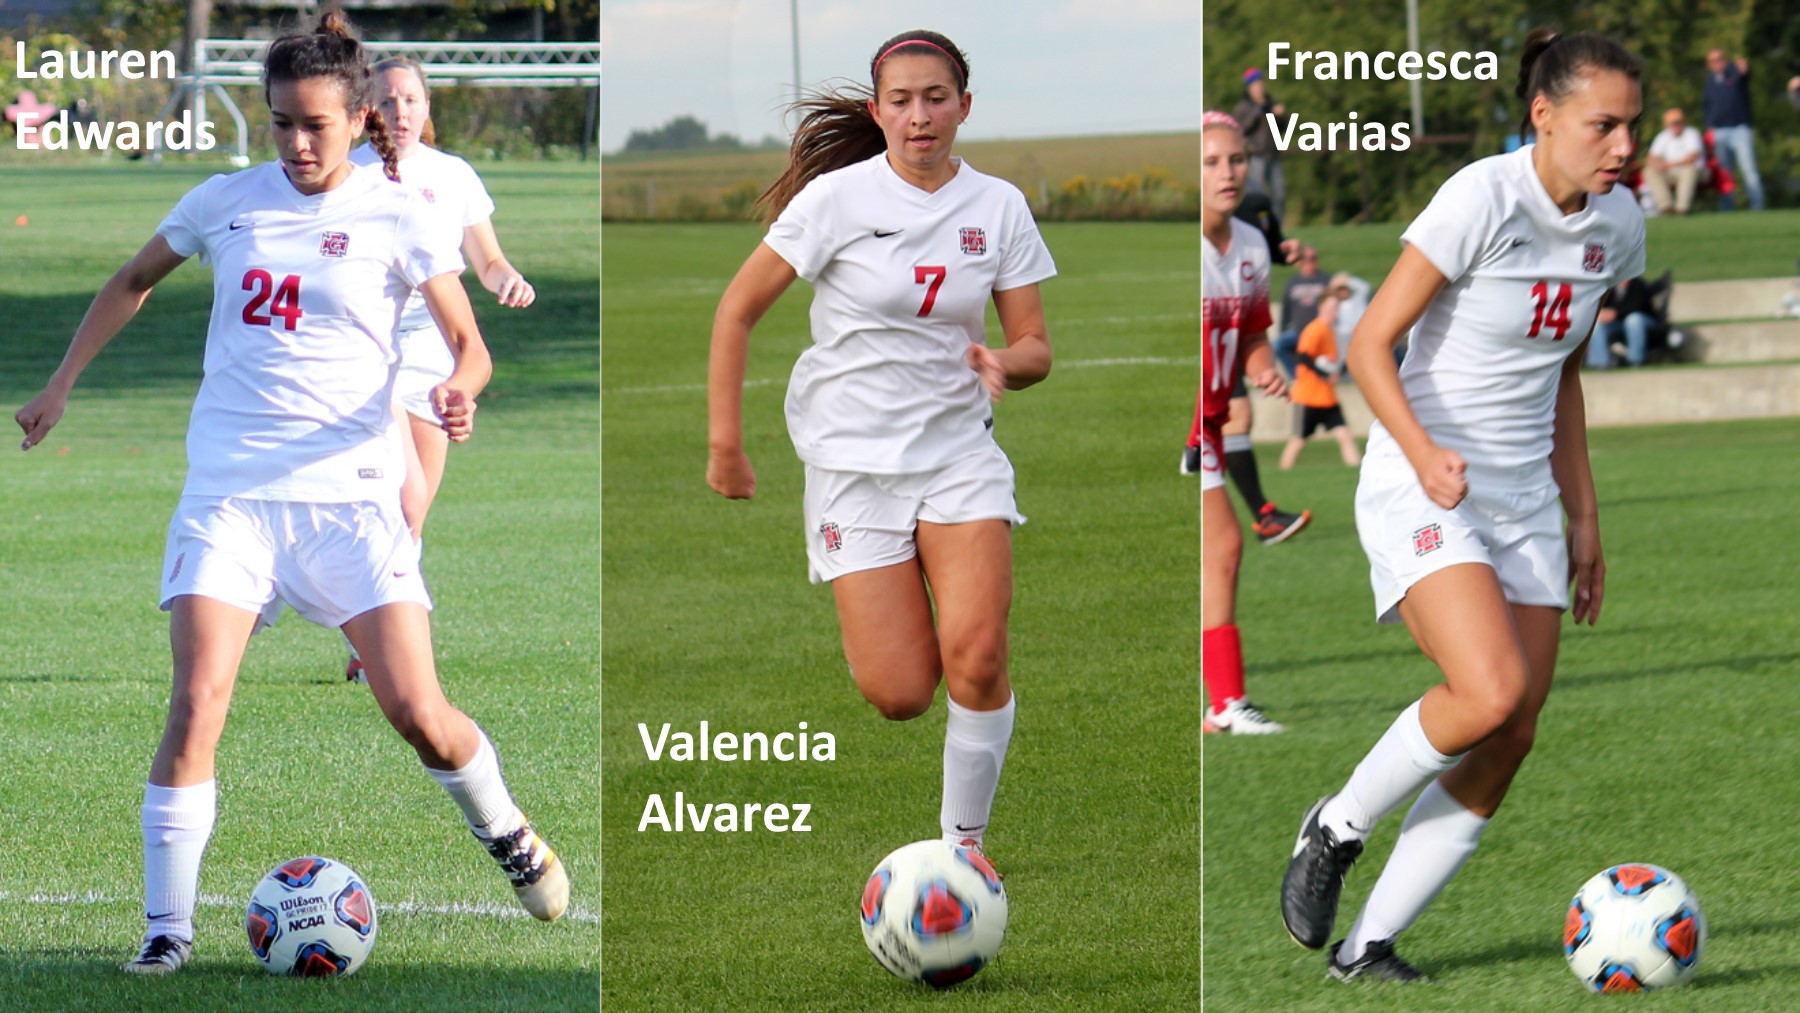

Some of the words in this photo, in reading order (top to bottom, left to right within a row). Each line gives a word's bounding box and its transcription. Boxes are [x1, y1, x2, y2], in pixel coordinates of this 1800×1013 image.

[914, 265, 946, 318] 7
[1240, 261, 1254, 281] C
[242, 269, 304, 331] 24
[1526, 280, 1572, 341] 14
[1209, 328, 1239, 391] 11
[280, 896, 324, 911] Wilson
[289, 915, 325, 932] NCAA
